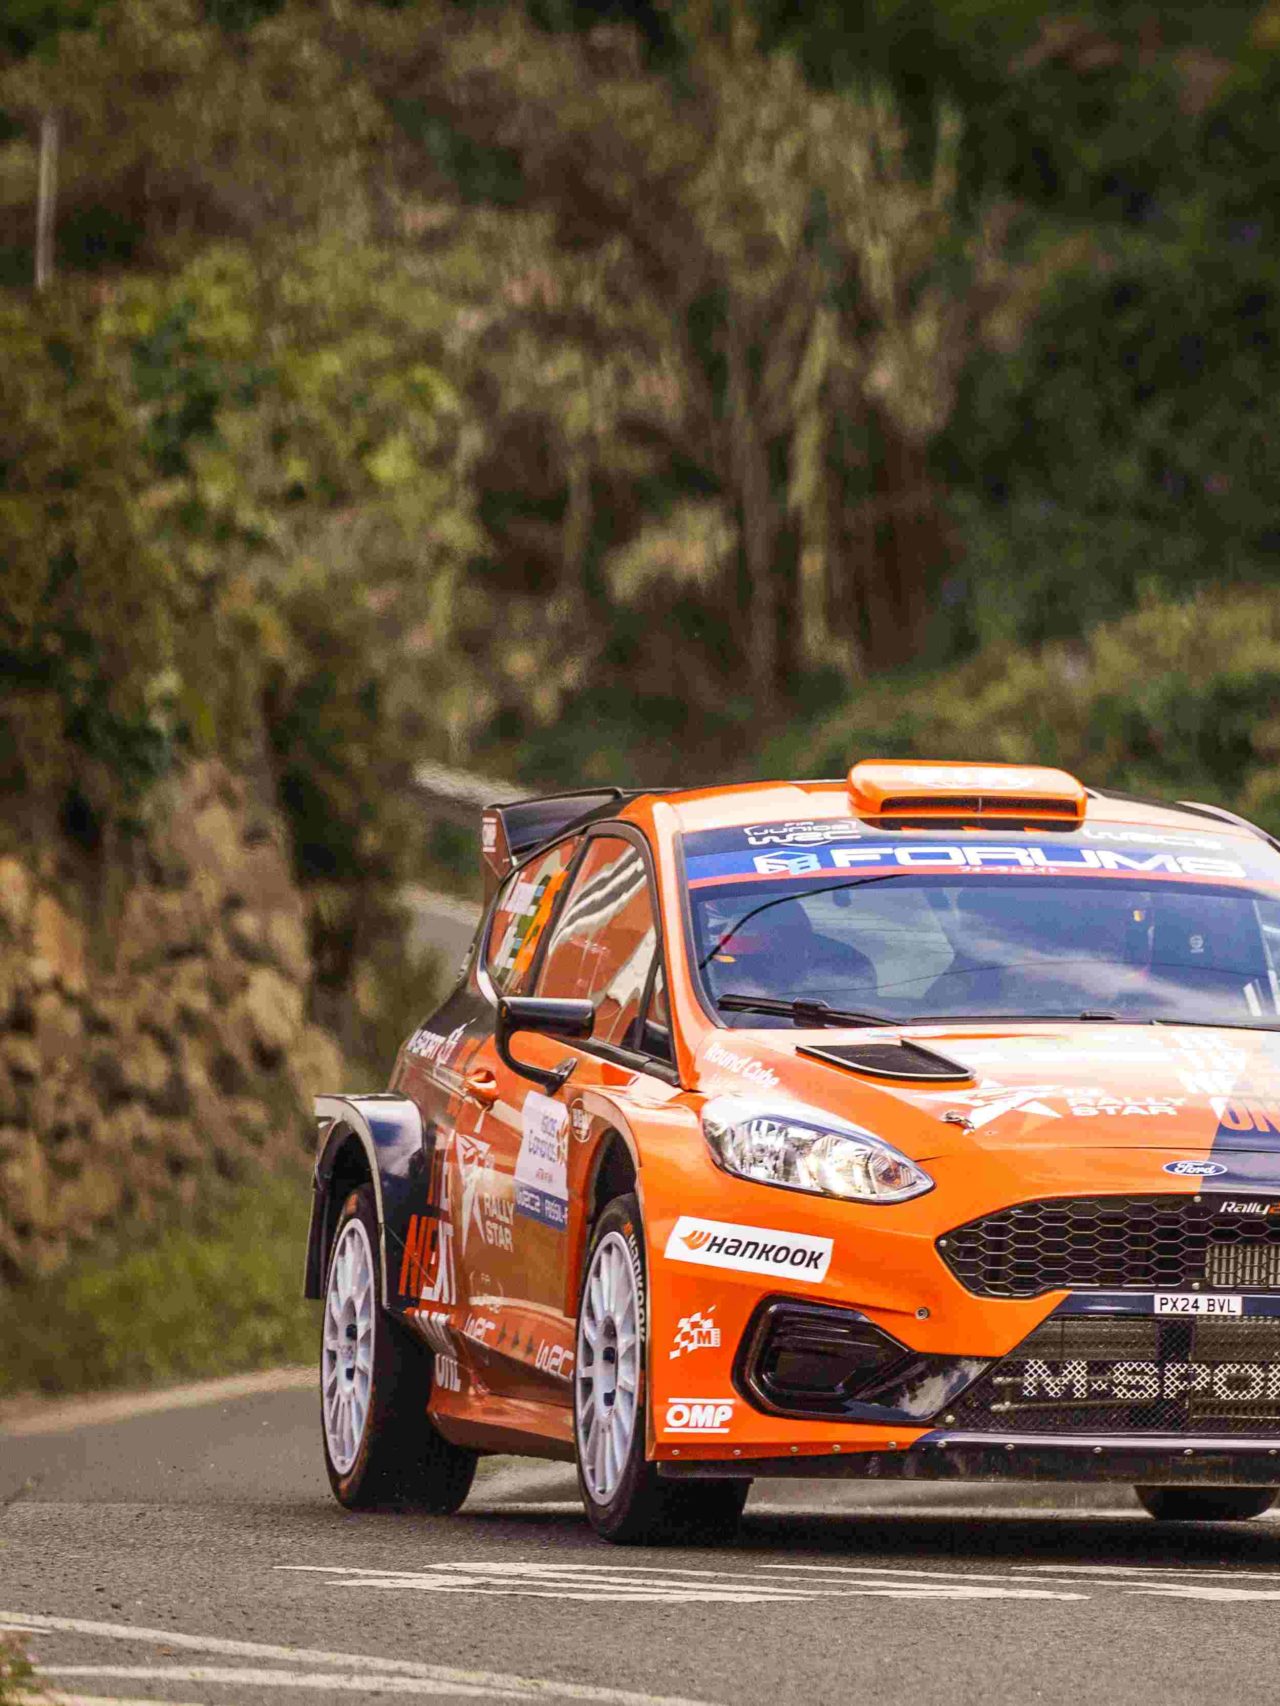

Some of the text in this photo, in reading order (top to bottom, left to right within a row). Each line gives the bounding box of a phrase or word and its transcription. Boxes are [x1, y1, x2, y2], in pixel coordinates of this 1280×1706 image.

[830, 846, 1247, 878] FORUM8
[1067, 1096, 1187, 1107] RALLY
[1071, 1105, 1178, 1117] STAR
[1174, 1161, 1216, 1175] Ford
[483, 1193, 514, 1226] RALLY
[485, 1219, 514, 1252] STAR
[1158, 1297, 1237, 1314] PX24 BVL
[665, 1404, 734, 1428] OMP
